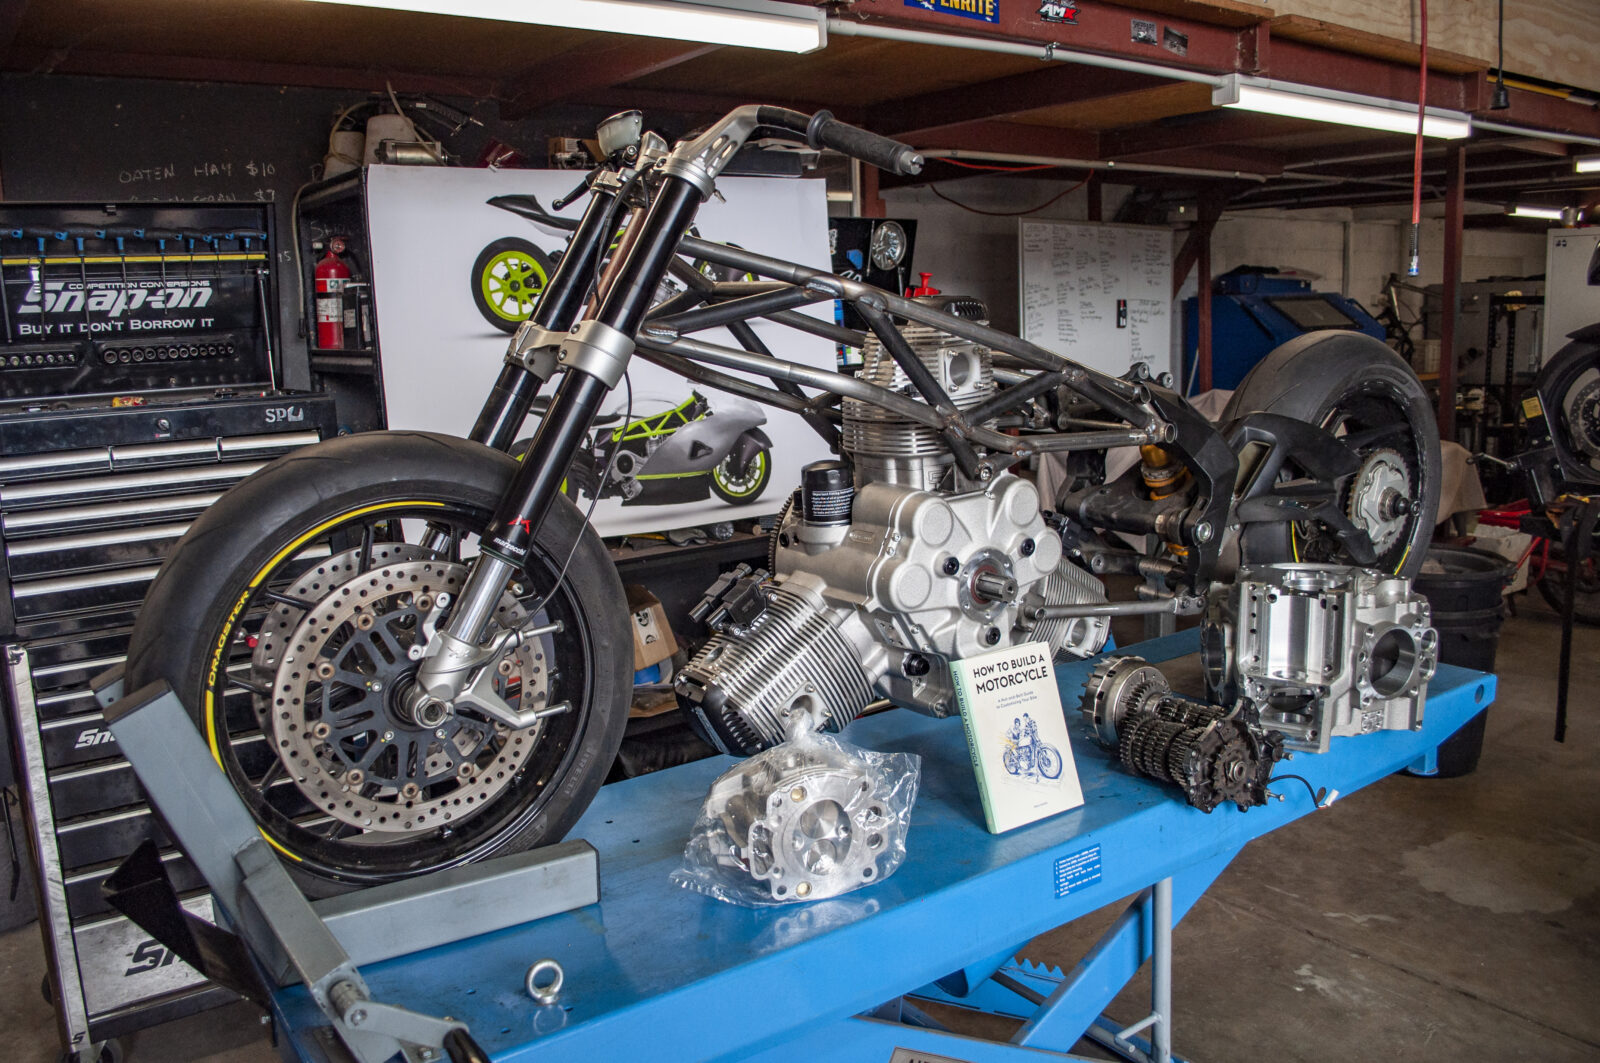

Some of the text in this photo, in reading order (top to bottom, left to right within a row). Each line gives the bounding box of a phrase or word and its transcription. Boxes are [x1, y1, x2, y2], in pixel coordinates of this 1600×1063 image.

[930, 0, 994, 16] NRITE
[1039, 3, 1077, 20] AMX
[246, 160, 275, 177] $10
[17, 282, 212, 317] Snap-on
[208, 590, 250, 687] DRAGSTER
[973, 653, 1045, 678] HOW TO BUILD A
[976, 666, 1048, 694] MOTORCYCLE
